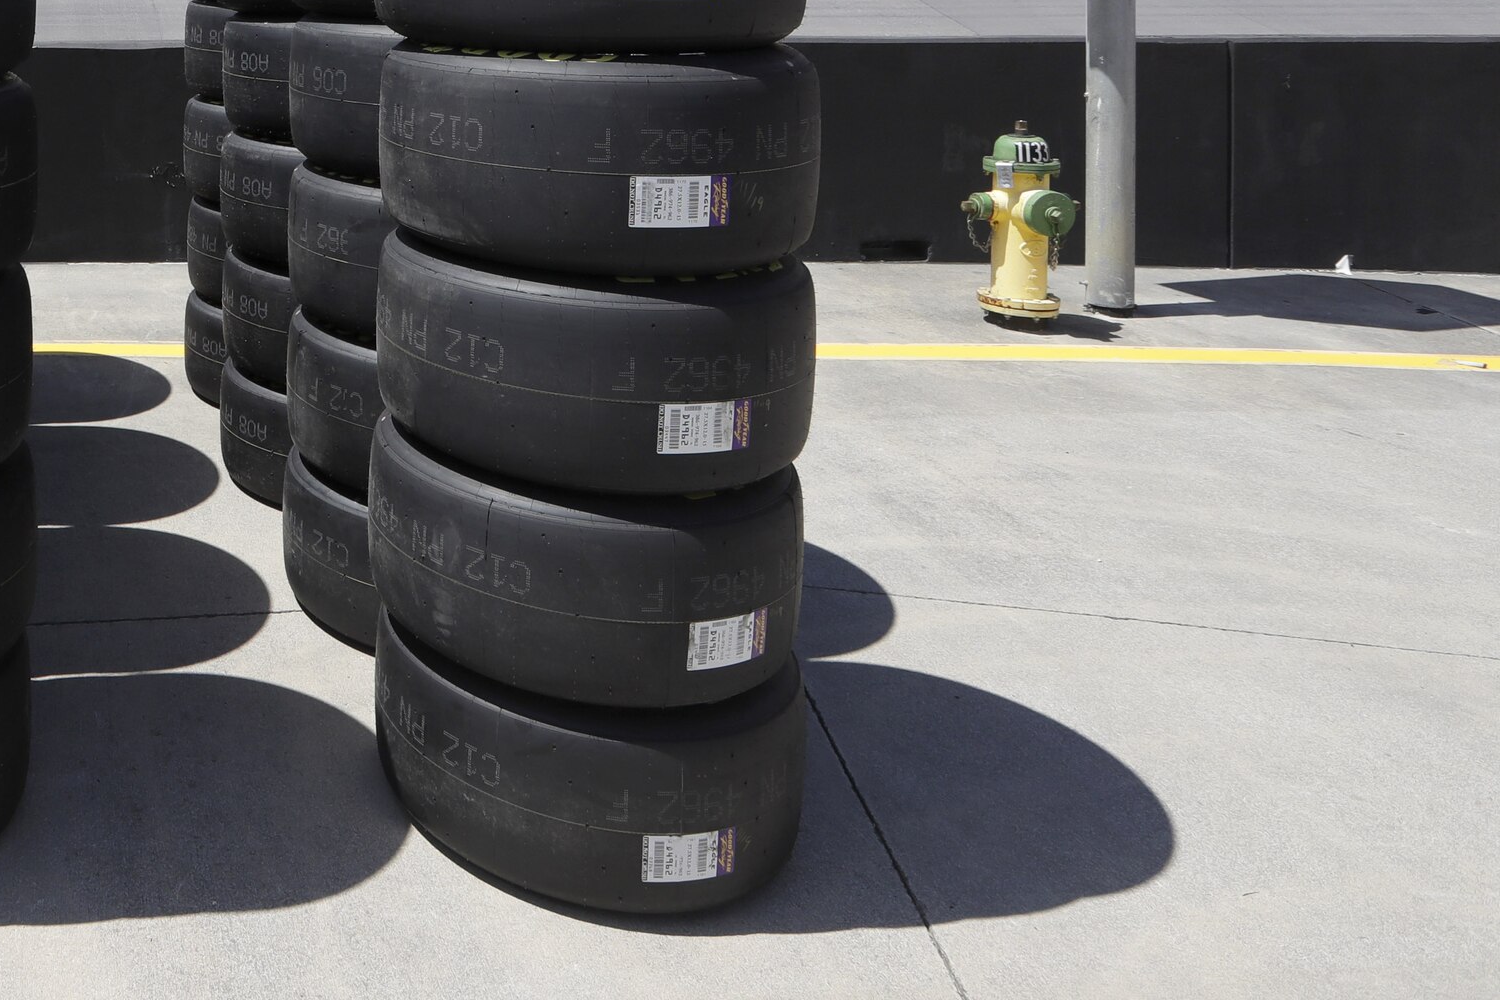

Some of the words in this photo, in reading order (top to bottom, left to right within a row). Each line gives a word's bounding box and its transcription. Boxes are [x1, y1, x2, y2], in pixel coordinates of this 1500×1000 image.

[1014, 141, 1049, 163] 1133
[653, 187, 662, 220] D4962
[680, 414, 690, 446] D4962
